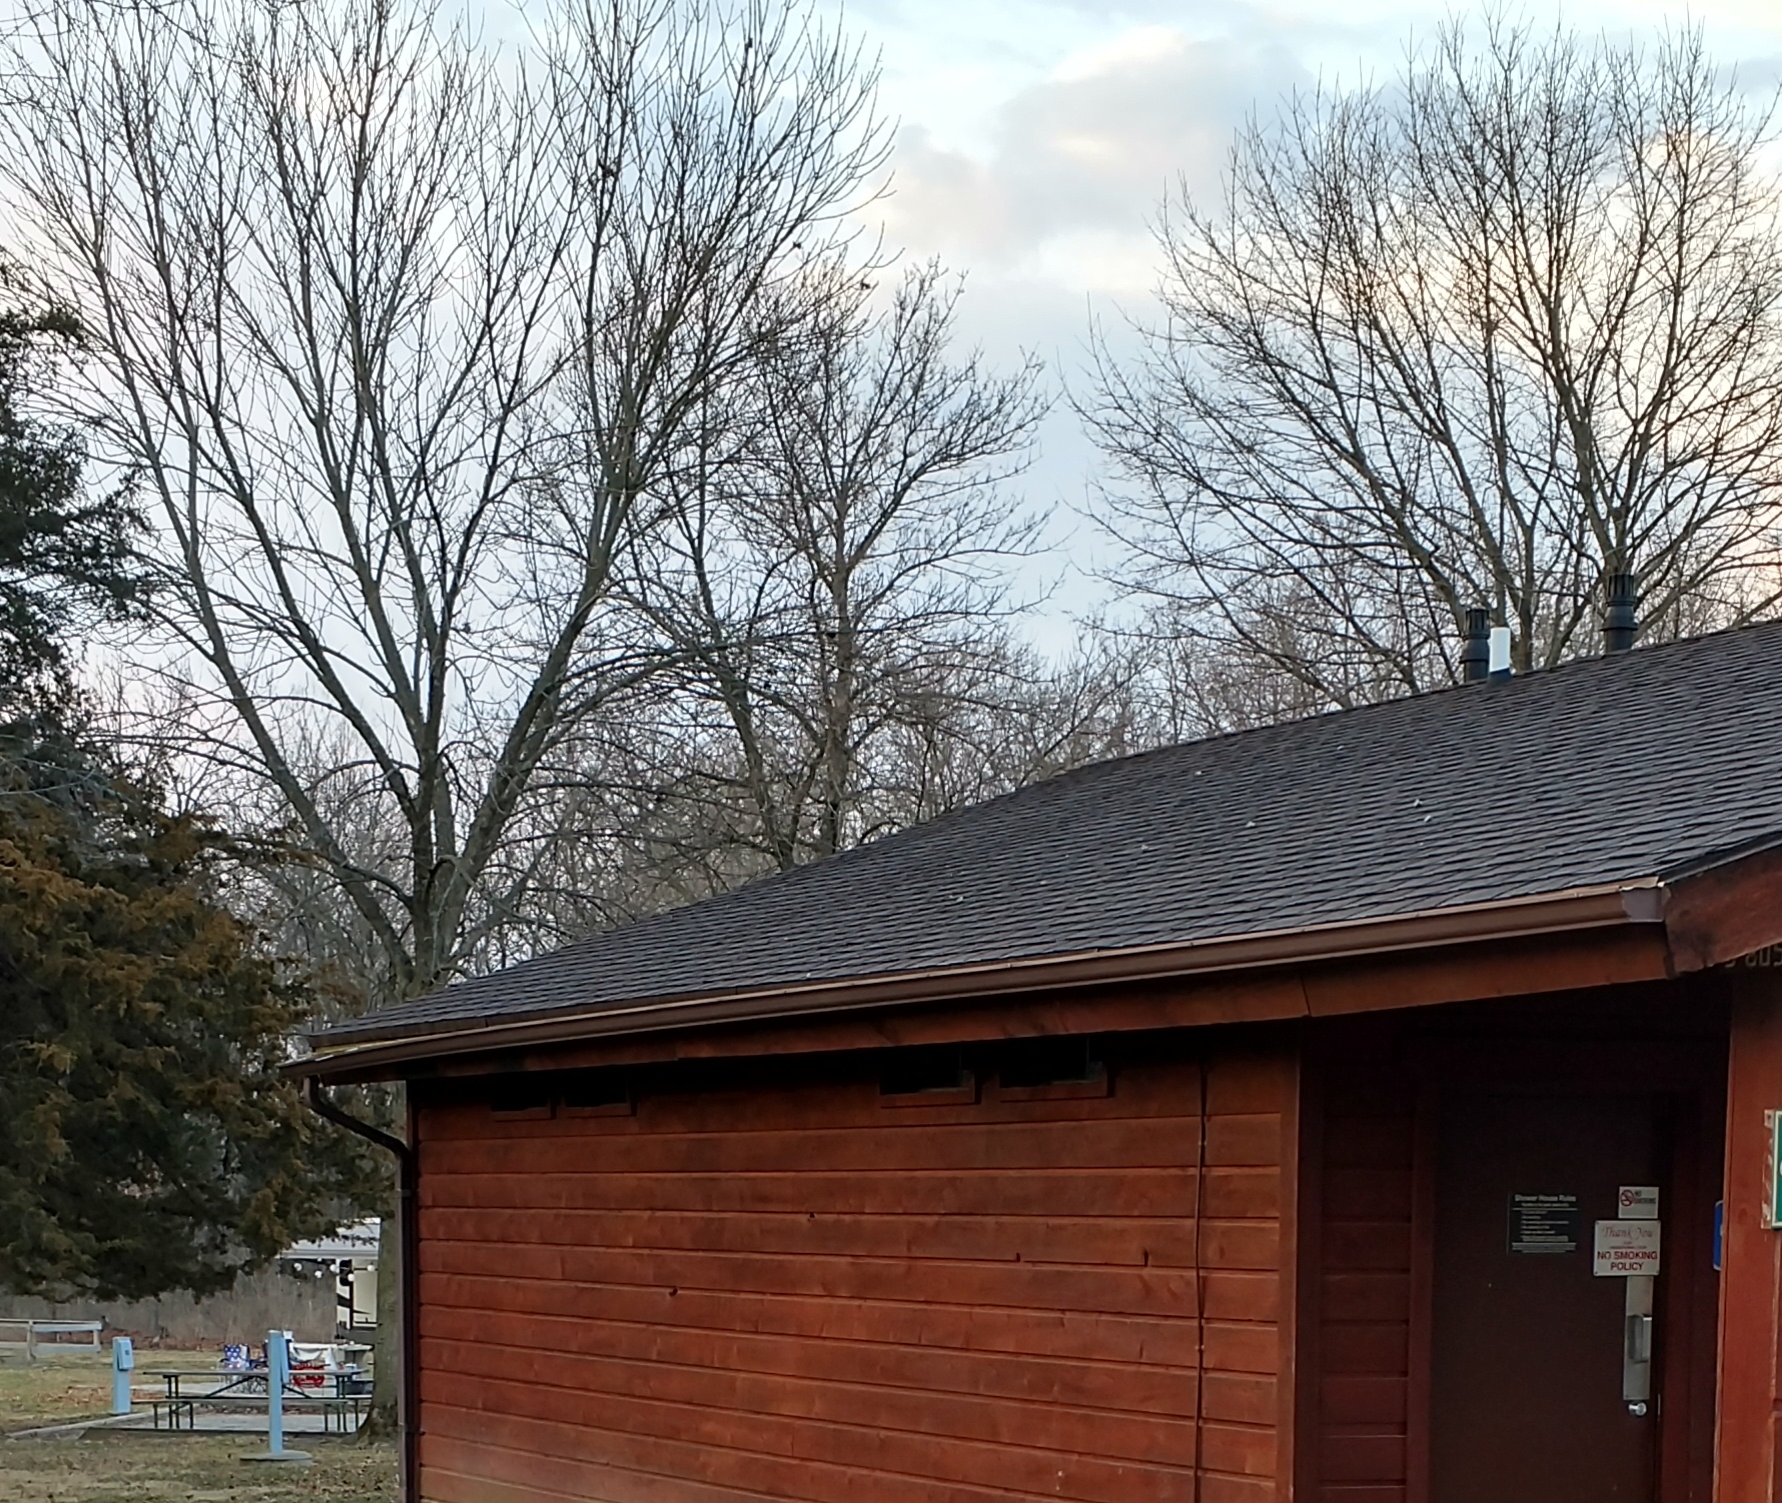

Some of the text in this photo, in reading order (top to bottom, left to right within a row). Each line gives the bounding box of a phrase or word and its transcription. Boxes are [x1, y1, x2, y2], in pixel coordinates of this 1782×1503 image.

[1597, 1251, 1658, 1260] NO SMOKING
[1610, 1262, 1644, 1271] POLICY
